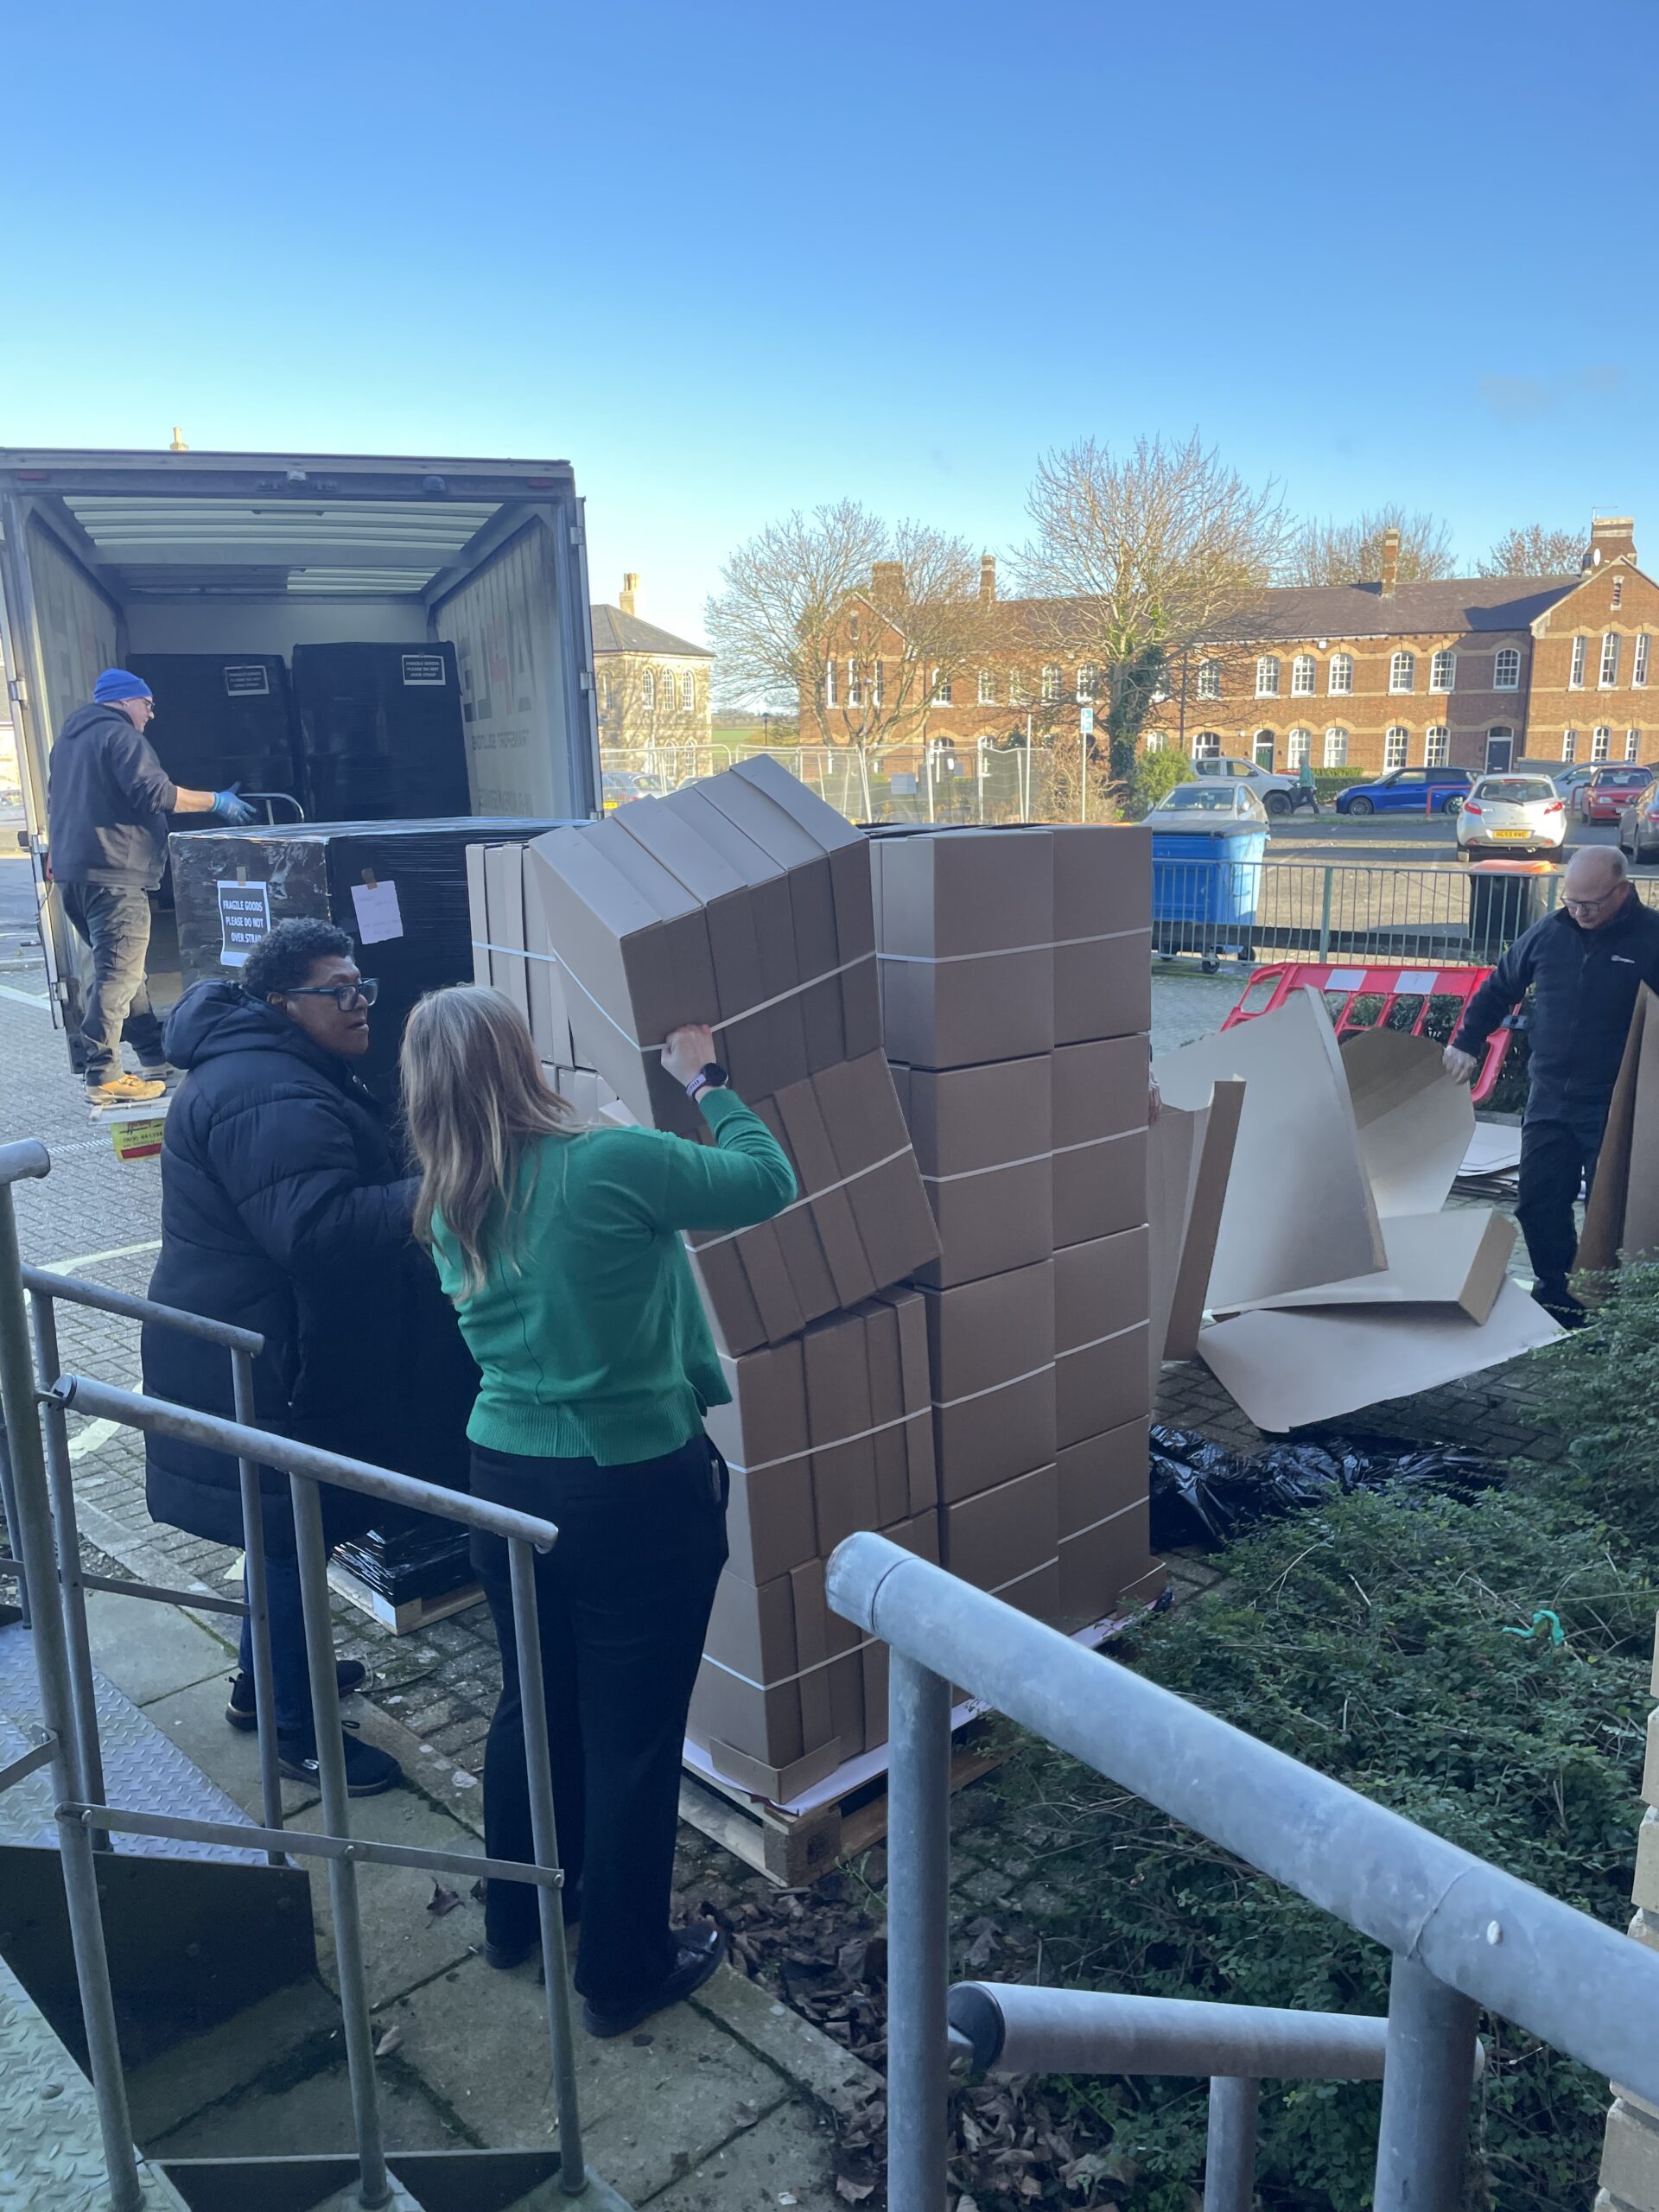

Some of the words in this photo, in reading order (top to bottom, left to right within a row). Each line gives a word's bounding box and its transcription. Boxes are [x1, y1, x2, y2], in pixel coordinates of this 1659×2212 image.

[222, 900, 244, 911] FRAGILE
[245, 900, 263, 912] GOODS
[226, 916, 244, 926] PLEASE
[245, 917, 251, 927] DO
[252, 918, 264, 928] NOT
[231, 932, 245, 943] OVER
